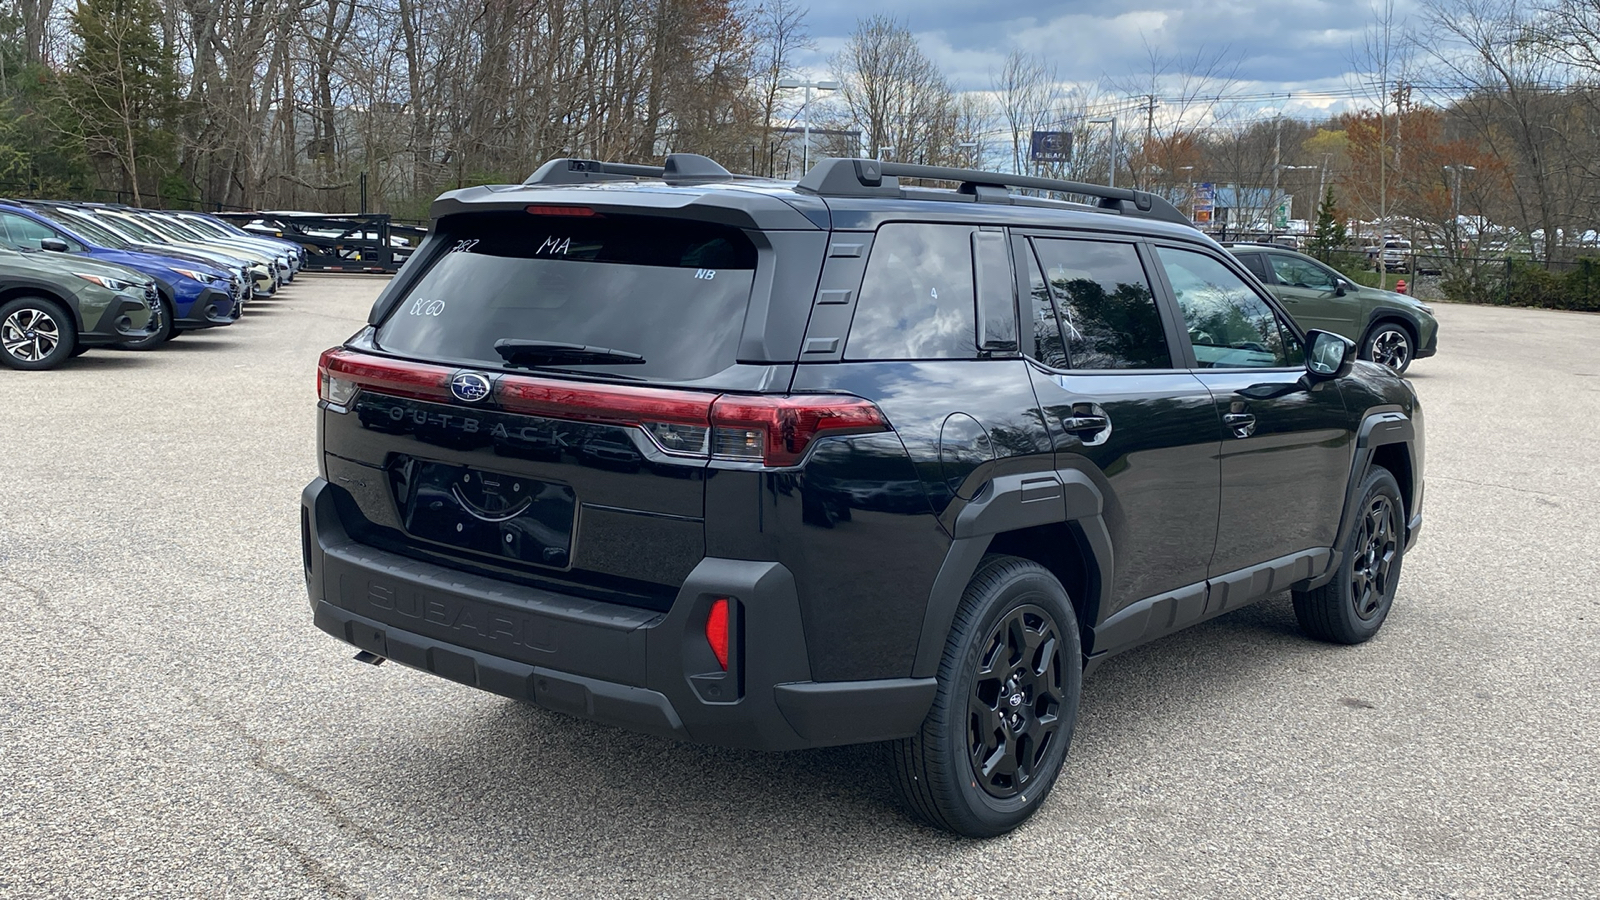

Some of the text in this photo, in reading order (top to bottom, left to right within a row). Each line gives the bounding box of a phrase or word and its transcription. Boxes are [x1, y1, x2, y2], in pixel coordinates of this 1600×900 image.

[535, 235, 571, 255] MA
[694, 268, 716, 280] NB
[388, 405, 570, 448] OUTBACK
[367, 579, 560, 654] SUBARU
